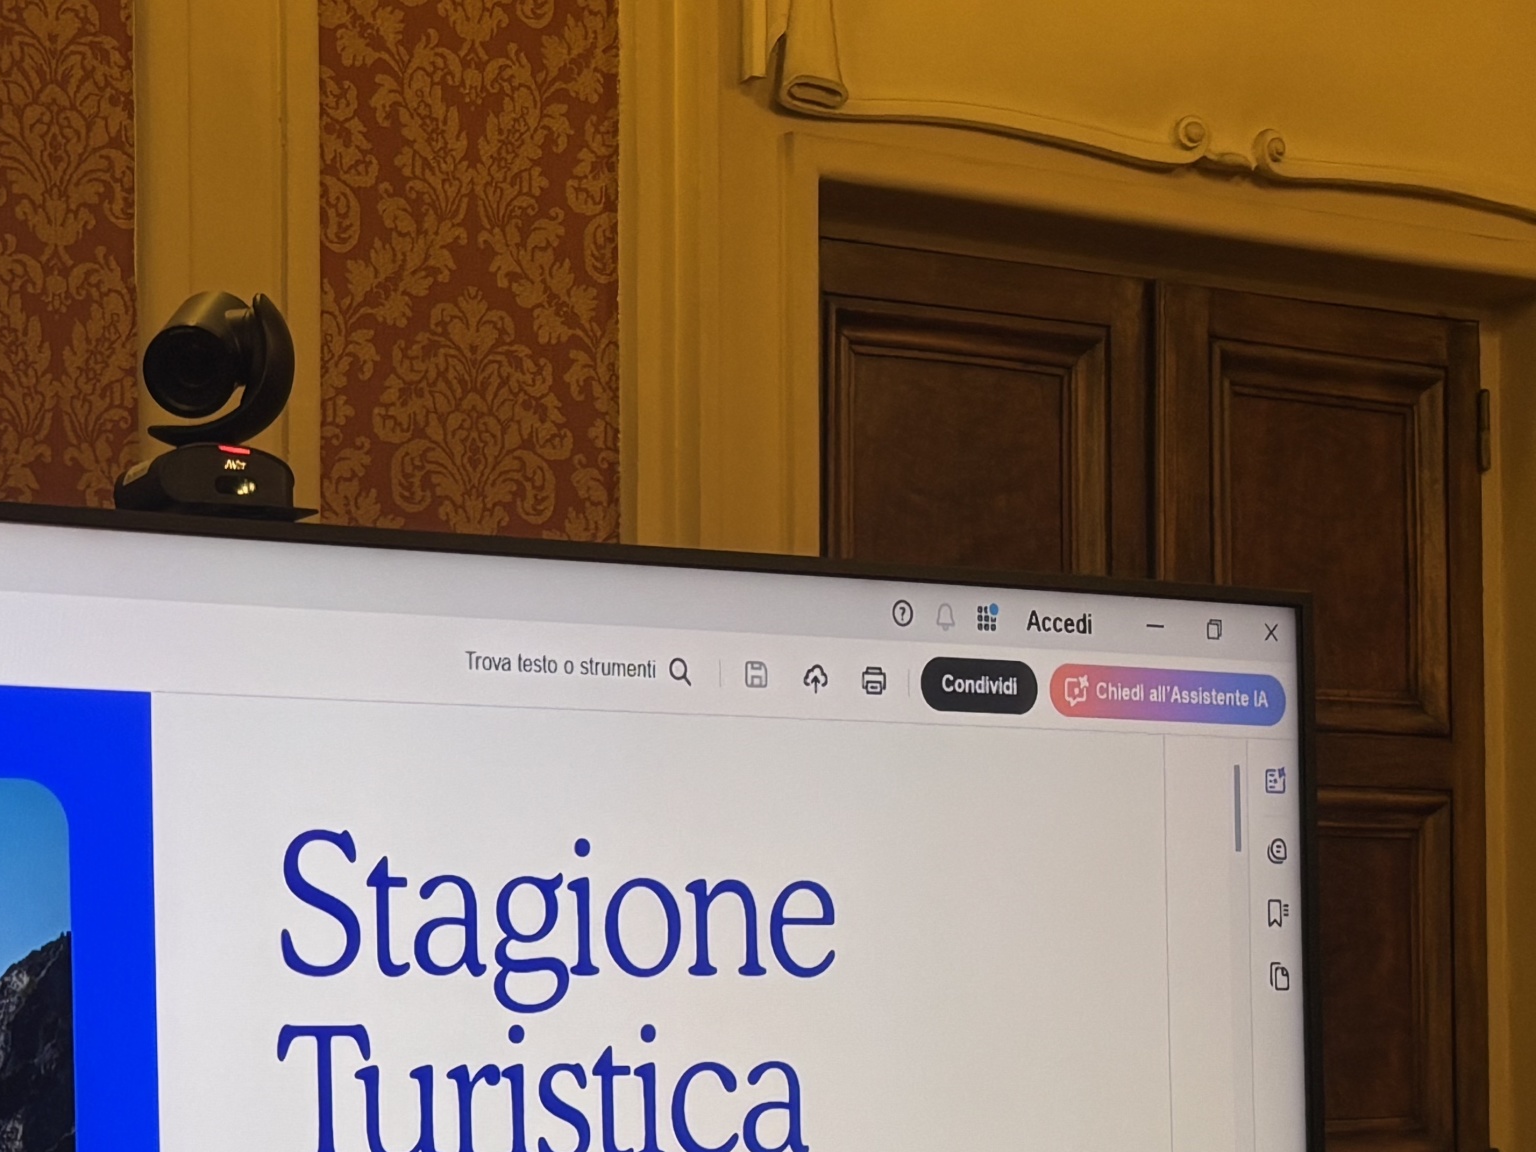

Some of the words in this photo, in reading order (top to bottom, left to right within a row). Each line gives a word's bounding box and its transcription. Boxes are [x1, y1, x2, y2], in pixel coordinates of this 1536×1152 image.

[1026, 609, 1092, 635] Accedi
[465, 650, 512, 672] Trova
[517, 653, 558, 674] testo
[563, 659, 575, 675] o
[580, 657, 656, 679] strumenti
[941, 673, 1018, 695] Condividi
[1096, 681, 1145, 702] Chiedi
[1149, 684, 1250, 707] all'Assistente
[1253, 689, 1269, 708] IA
[280, 829, 836, 1014] Stagione
